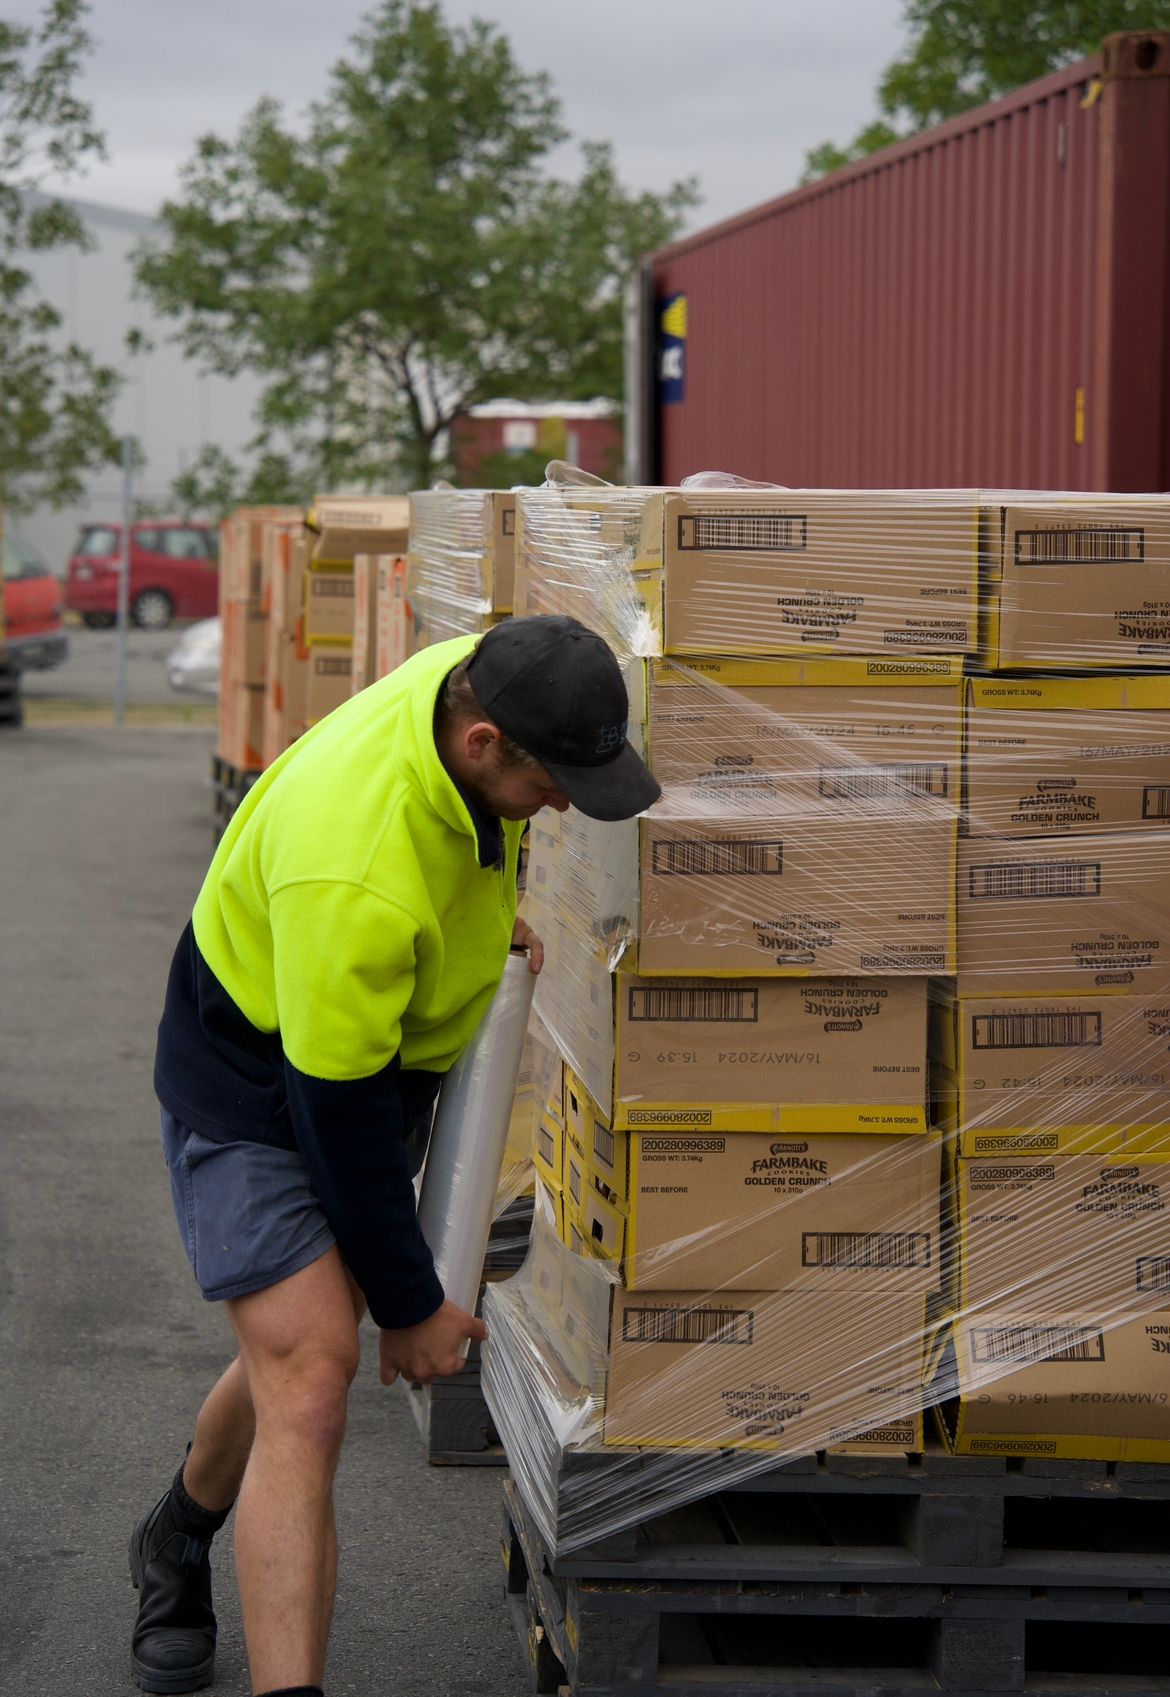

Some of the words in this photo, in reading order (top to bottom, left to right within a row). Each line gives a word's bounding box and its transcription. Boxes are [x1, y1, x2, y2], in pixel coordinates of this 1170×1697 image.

[777, 598, 820, 606] CRUNCH
[1114, 610, 1158, 620] CRUNCH
[1020, 689, 1042, 697] 3.74Kg
[1018, 793, 1096, 811] FARMBAKE
[1011, 813, 1053, 822] GOLDEN
[1055, 812, 1100, 821] CRUNCH
[753, 921, 796, 930] CRUNCH
[800, 921, 841, 930] GOLDEN
[1071, 942, 1115, 951] CRUNCH
[1117, 941, 1160, 950] GOLDEN
[800, 989, 844, 998] CRUNCH
[847, 989, 888, 998] GOLDEN
[804, 999, 882, 1018] FARMBAKE
[627, 1051, 641, 1063] G
[656, 1051, 697, 1063] 15:39
[717, 1051, 821, 1064] 16/MAY/2024
[872, 1065, 901, 1073] BEFORE
[972, 1079, 986, 1090] G
[629, 1112, 710, 1123] 200280996389
[858, 1115, 880, 1123] 3.74Kg
[895, 1116, 919, 1124] GROSS
[644, 1140, 723, 1150] 200280996389
[681, 1155, 703, 1163] 3.74Kg
[751, 1157, 828, 1175] FARMBAKE
[767, 1169, 811, 1177] COOKIES
[972, 1167, 1052, 1179] 200280996389
[744, 1177, 786, 1186] GOLDEN
[788, 1177, 832, 1186] CRUNCH
[1081, 1182, 1160, 1198] FARMBAKE
[1145, 1325, 1170, 1335] NCH
[978, 1394, 992, 1405] G
[1007, 1393, 1049, 1404] 15:46
[972, 1441, 1055, 1451] 200280996389
